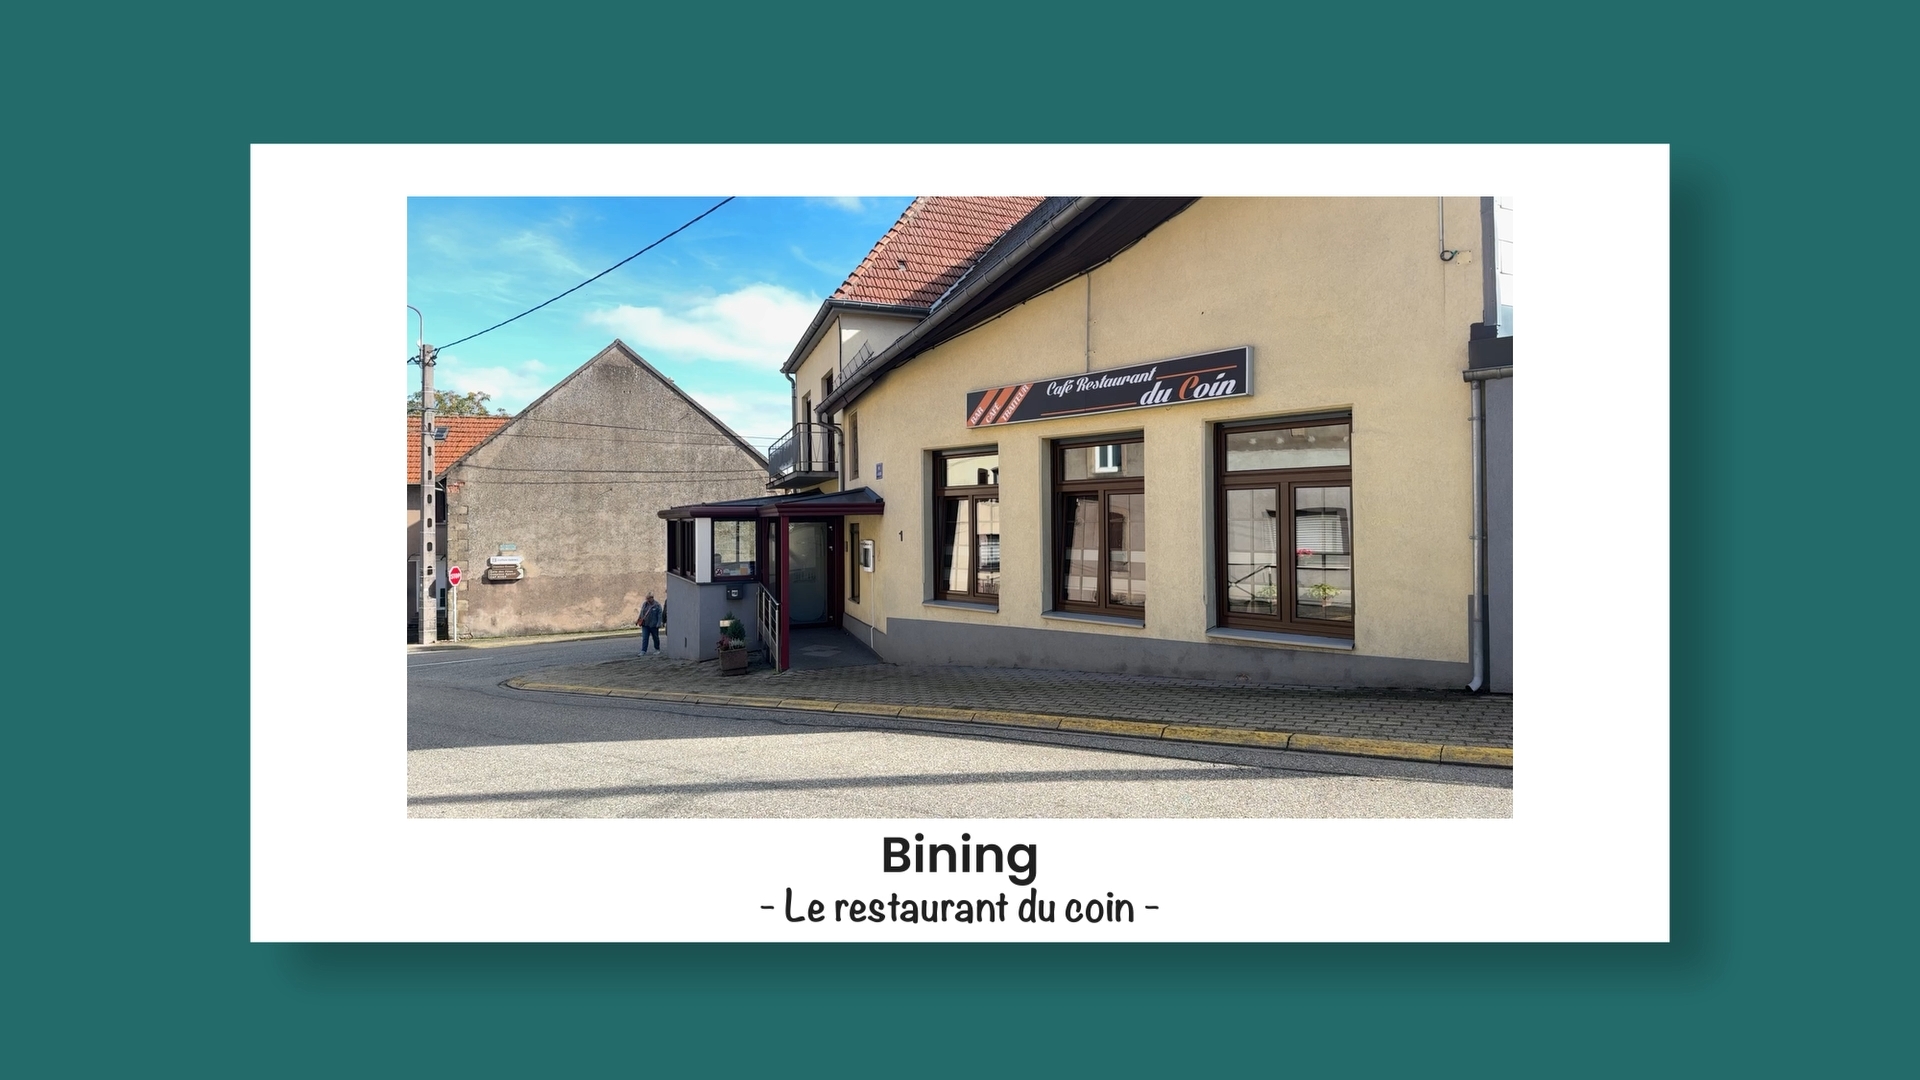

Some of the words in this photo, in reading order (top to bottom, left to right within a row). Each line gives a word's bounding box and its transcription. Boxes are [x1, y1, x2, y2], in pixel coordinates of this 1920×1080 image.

[1047, 379, 1074, 397] Café
[1076, 366, 1158, 393] Restaurant
[1139, 380, 1173, 406] du
[1178, 372, 1237, 400] Coin
[970, 406, 984, 425] BAR
[1002, 384, 1029, 421] TRAITEUR
[899, 530, 903, 541] 1
